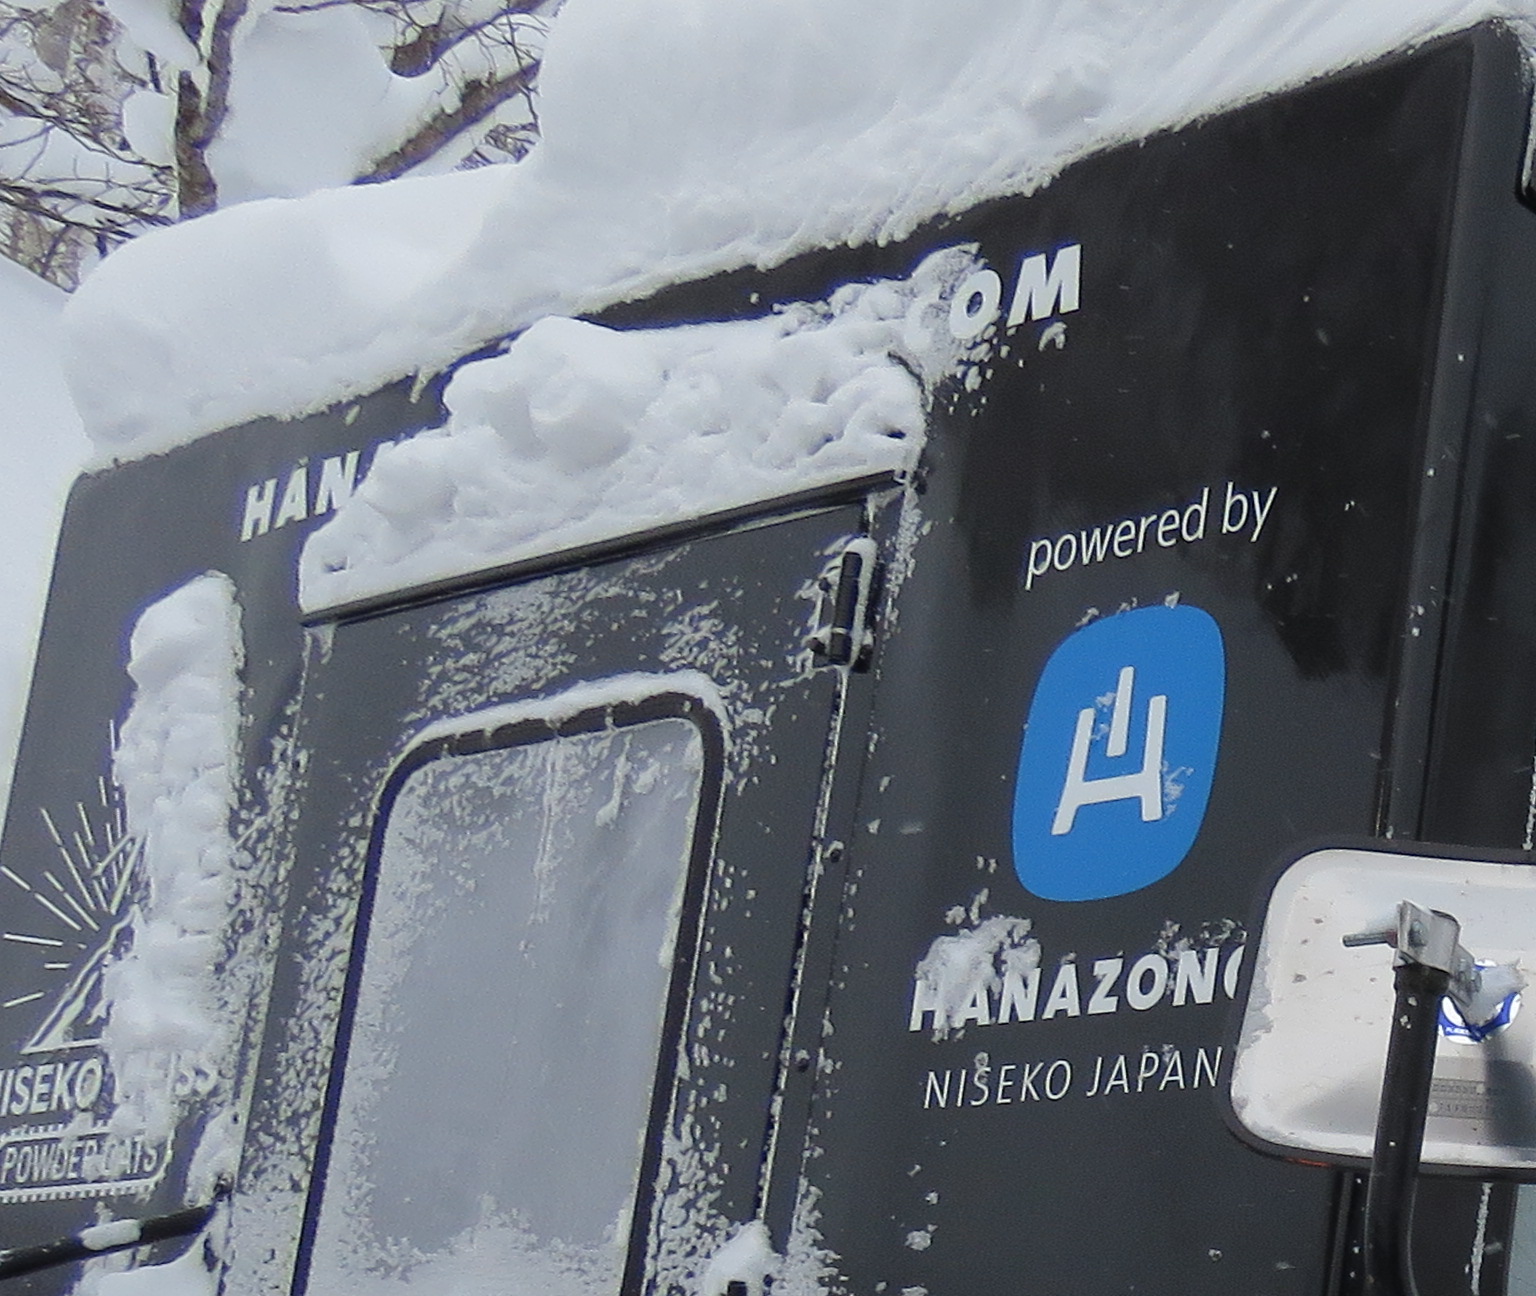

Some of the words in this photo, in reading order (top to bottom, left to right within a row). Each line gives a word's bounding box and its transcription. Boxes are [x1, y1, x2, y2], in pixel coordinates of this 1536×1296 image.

[241, 441, 395, 542] HAN
[1025, 486, 1209, 591] powered
[1222, 481, 1278, 543] by
[0, 1059, 103, 1116] ISEKO
[924, 1059, 1073, 1109] NISEKO
[1086, 1046, 1222, 1097] JAPAN
